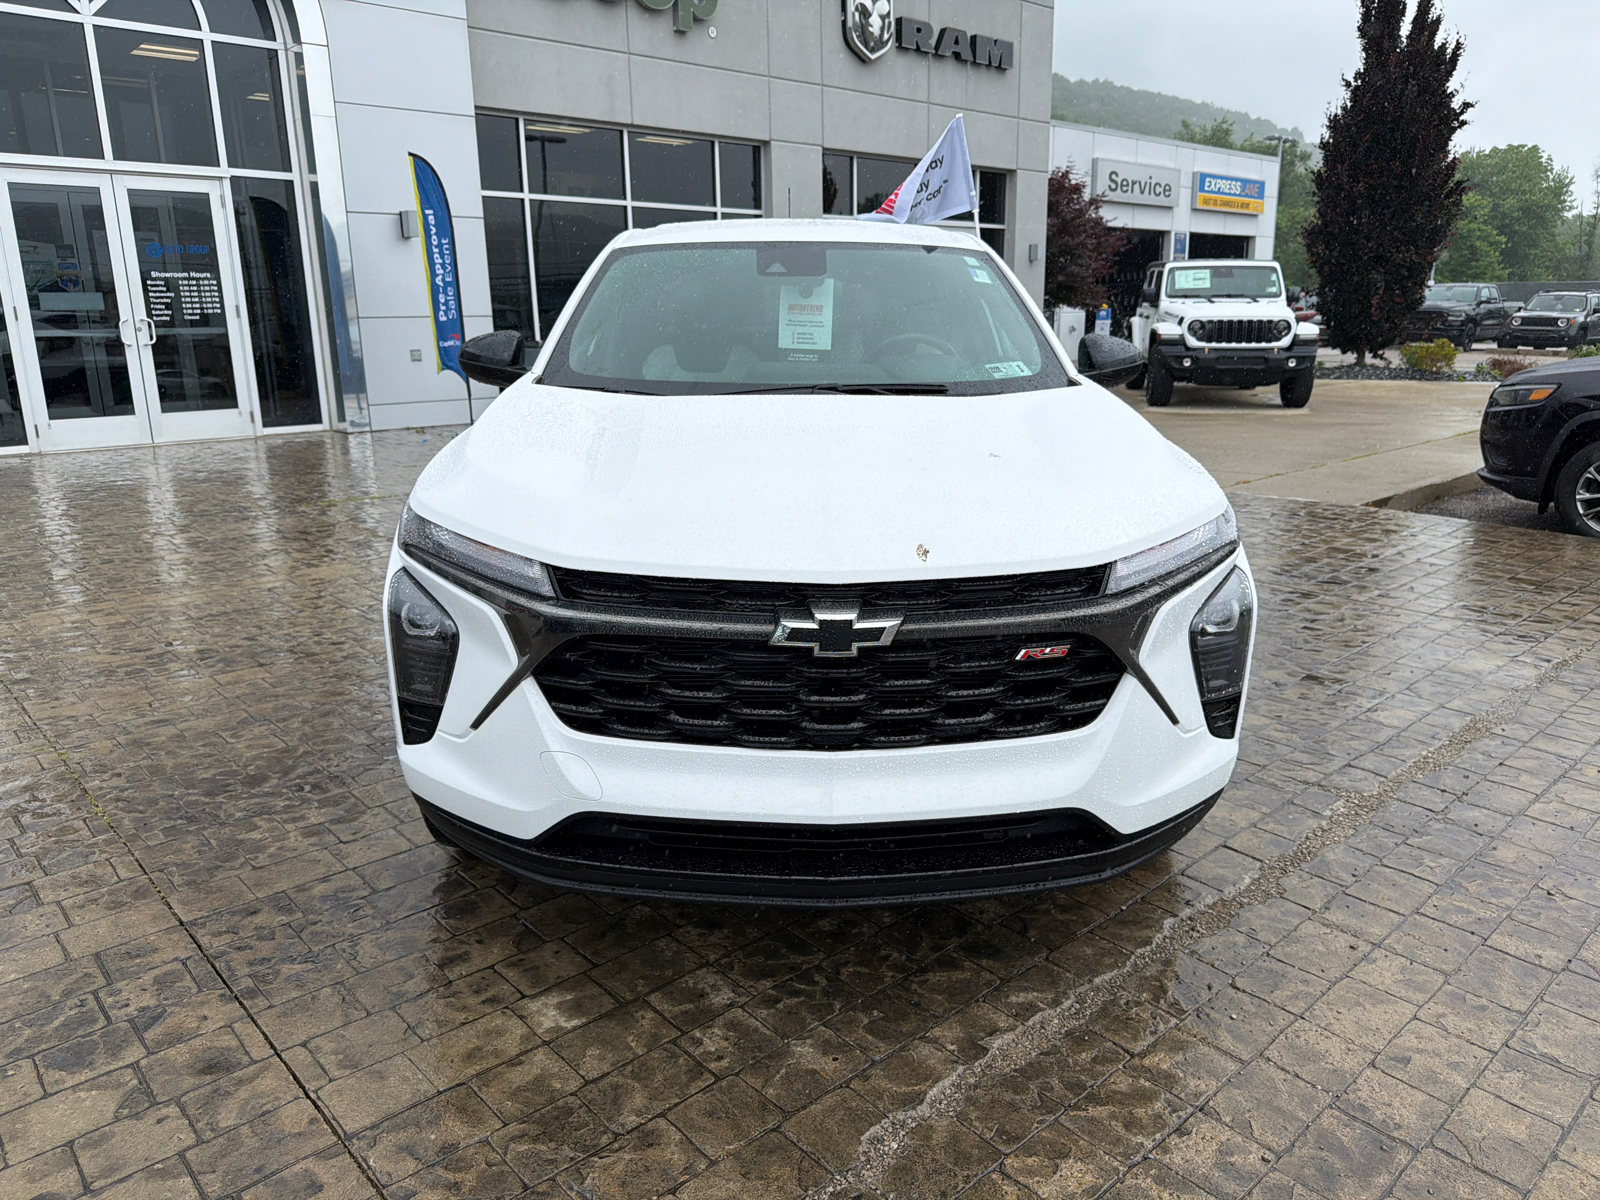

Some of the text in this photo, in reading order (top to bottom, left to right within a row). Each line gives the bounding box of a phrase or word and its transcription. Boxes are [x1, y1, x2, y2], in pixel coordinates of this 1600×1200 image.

[896, 16, 1014, 70] RAM
[916, 179, 930, 194] uy
[1108, 170, 1172, 198] Service
[186, 245, 210, 254] GROUP
[425, 209, 448, 322] Pre-Approval
[442, 238, 457, 319] Sale Event
[1015, 645, 1071, 660] RS
